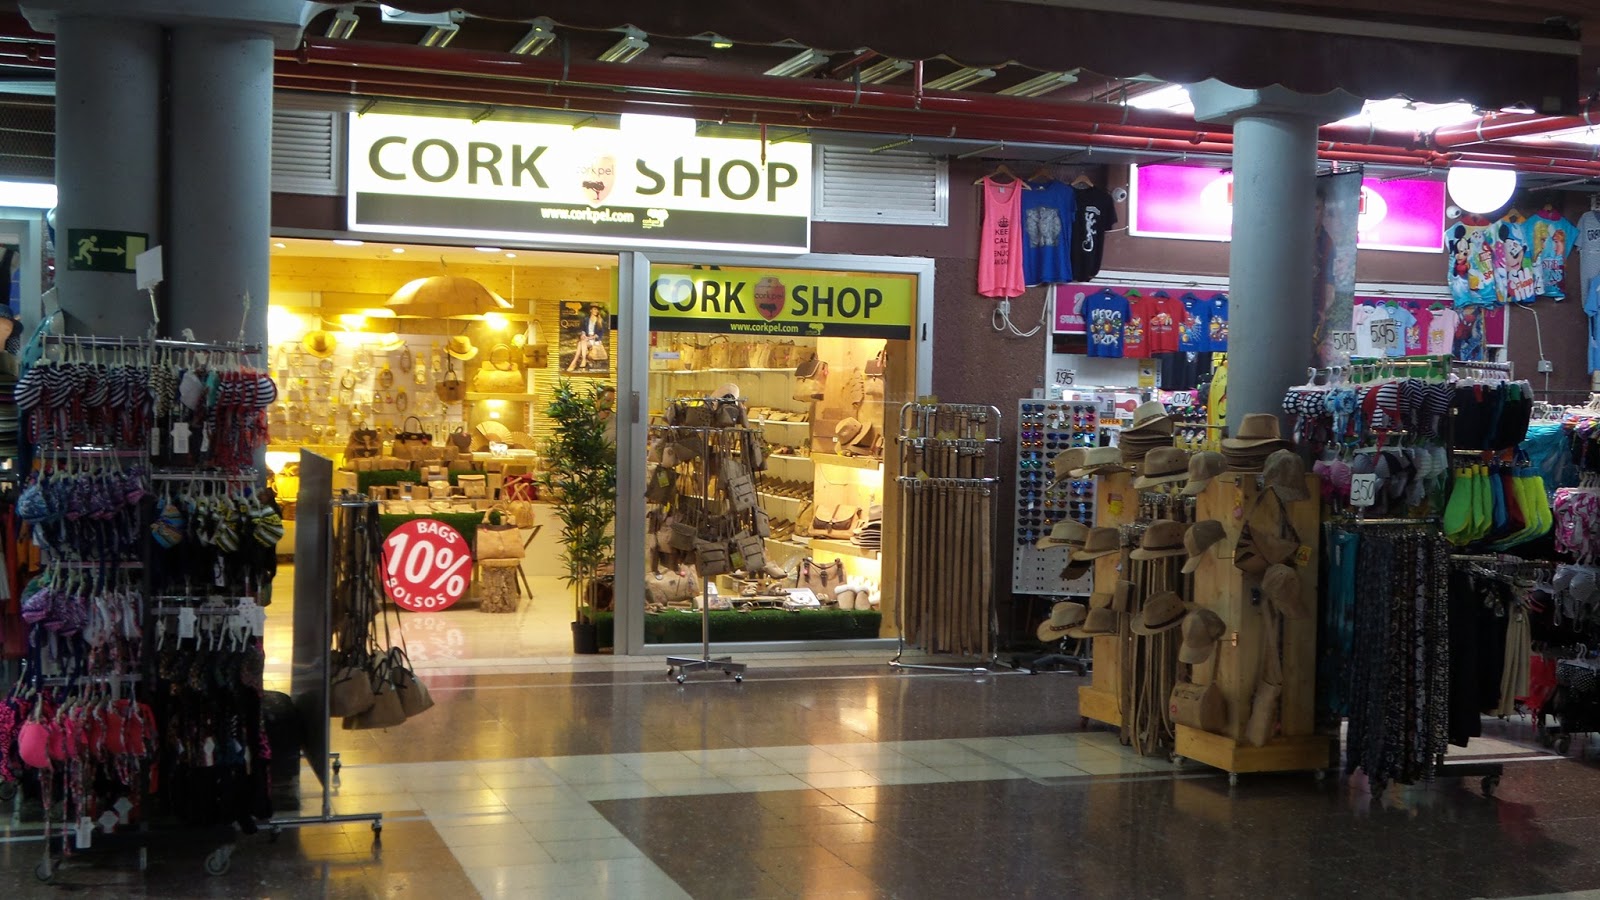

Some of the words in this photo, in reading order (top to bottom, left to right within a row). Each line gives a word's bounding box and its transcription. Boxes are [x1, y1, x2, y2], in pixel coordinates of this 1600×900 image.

[368, 135, 549, 188] CORK
[635, 156, 798, 202] SHOP
[541, 206, 634, 224] www.corkpel.com
[650, 278, 746, 314] CORK
[791, 285, 883, 318] SHOP
[755, 291, 784, 301] corkpel
[730, 322, 799, 334] www.corkpel.com
[416, 521, 459, 544] BAGS
[387, 532, 470, 597] 10%
[386, 577, 447, 608] BOLSOS
